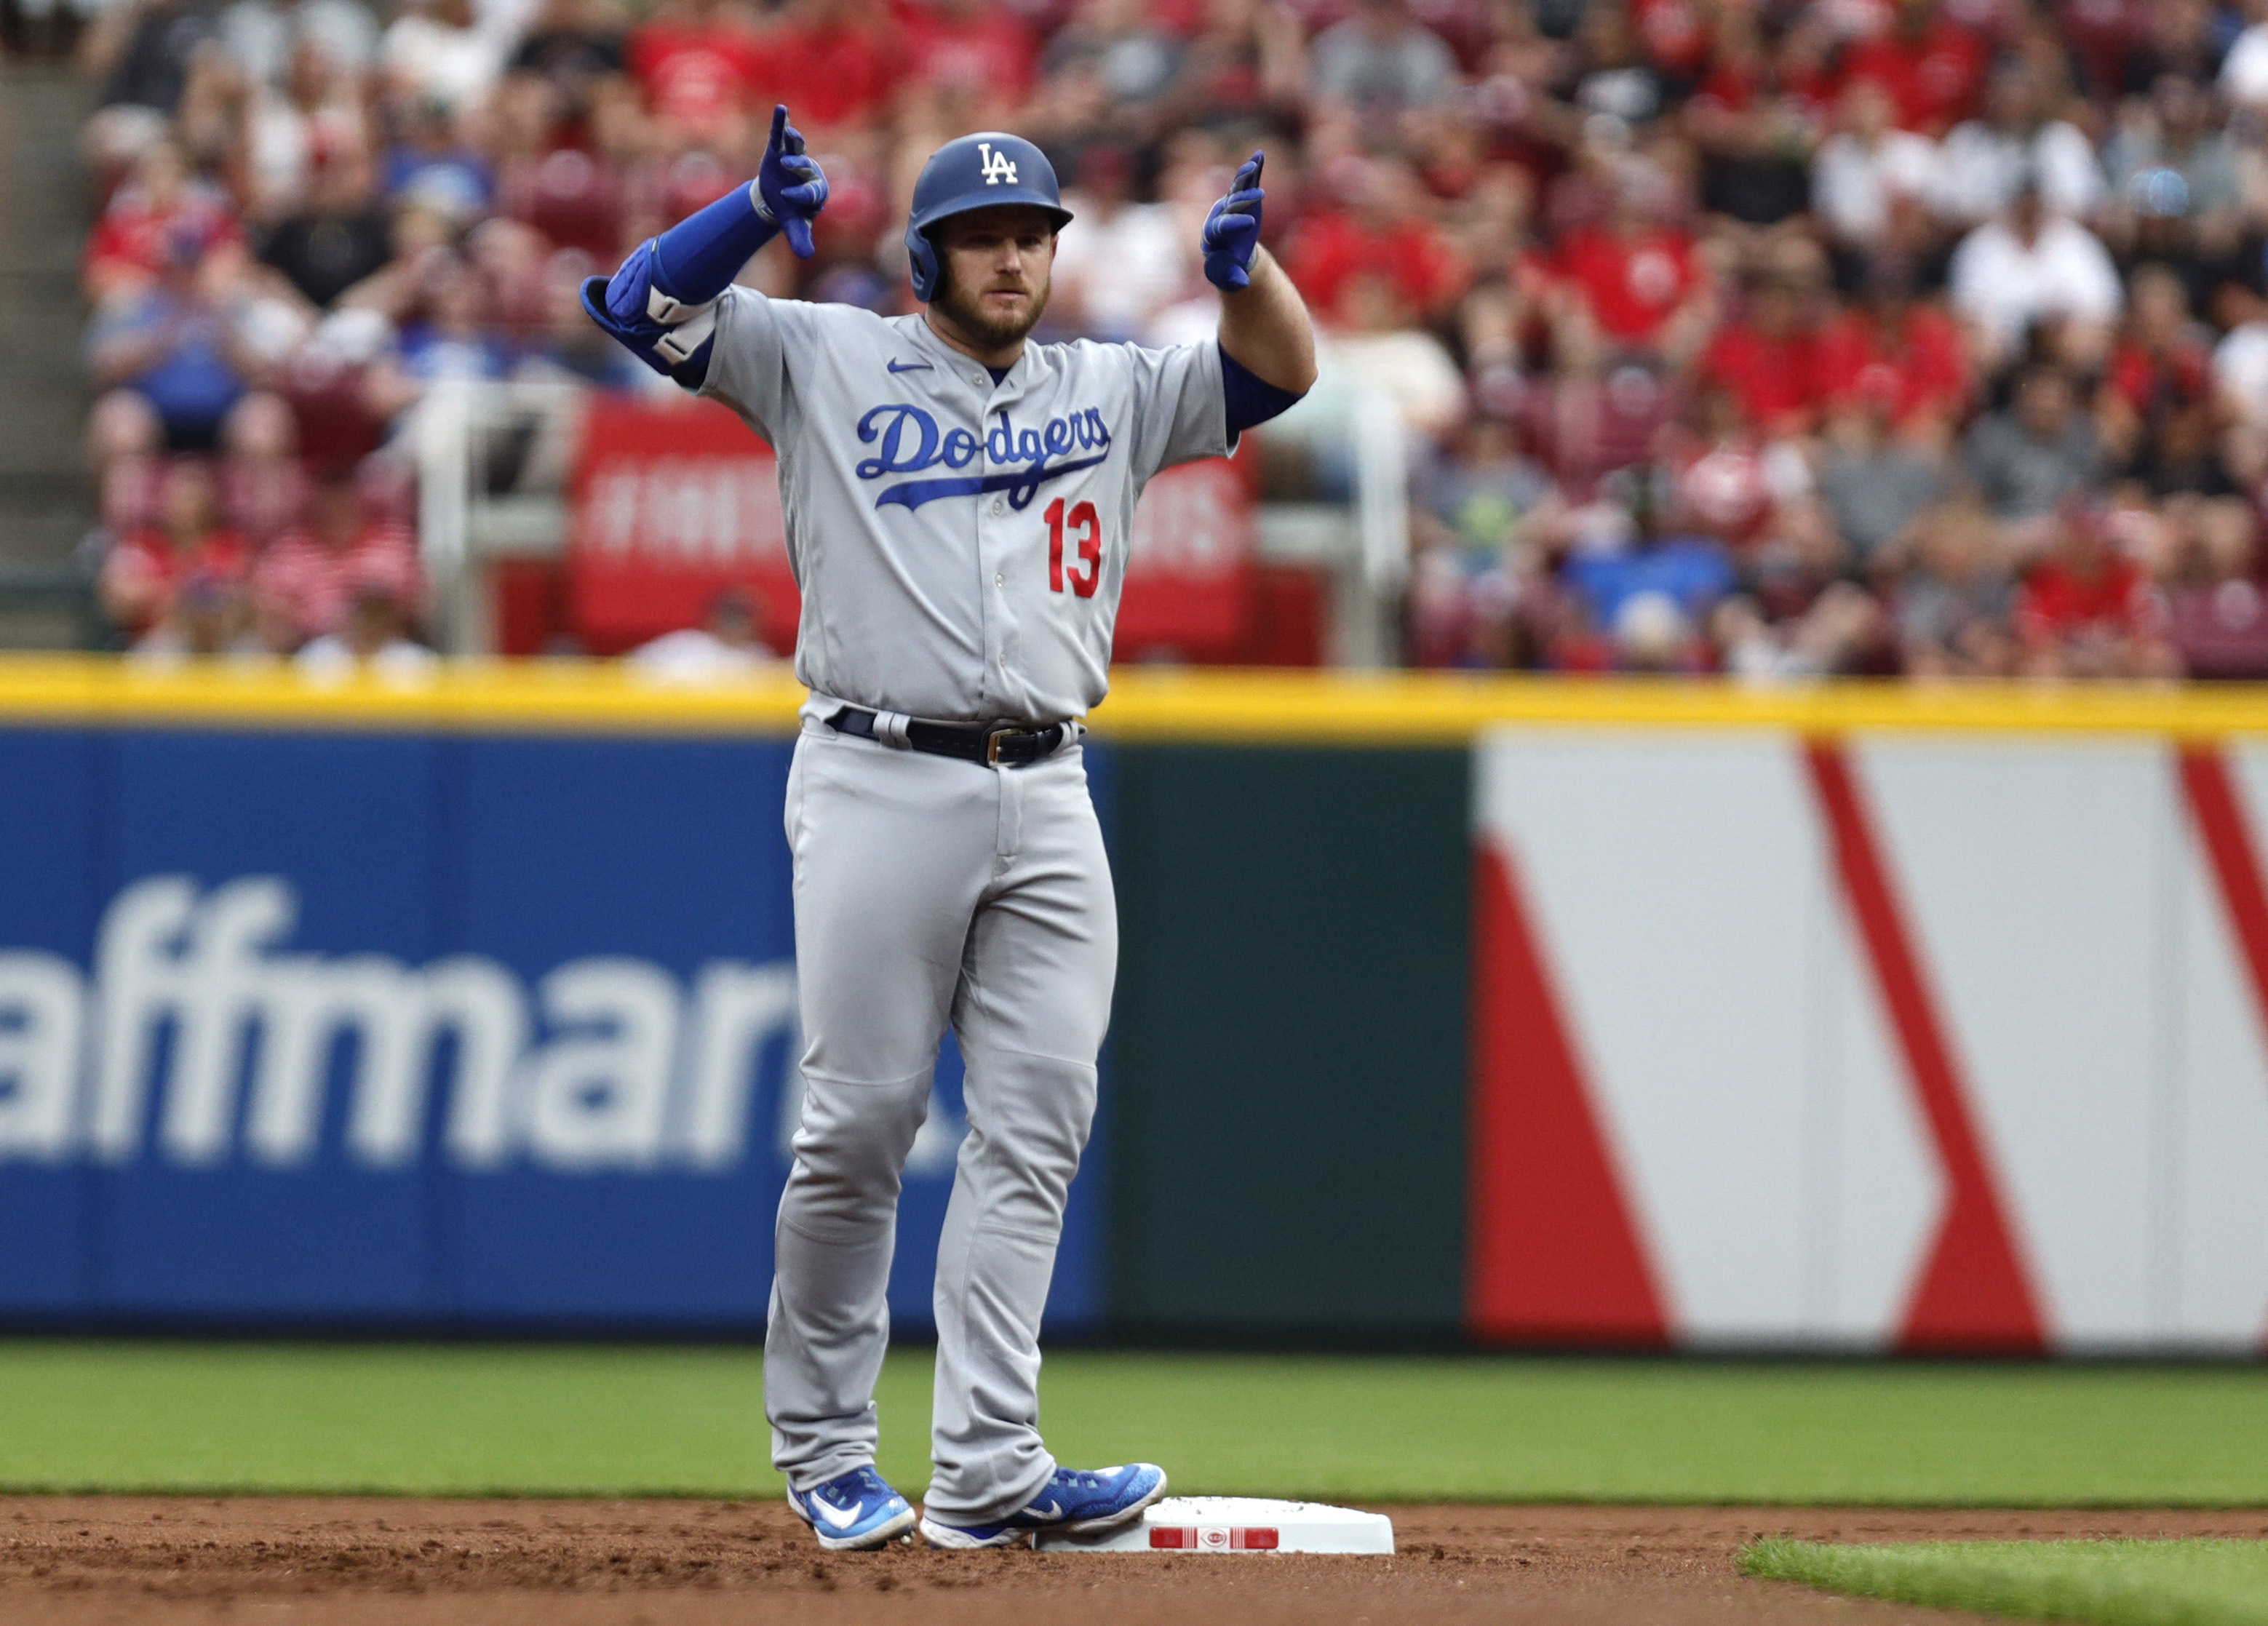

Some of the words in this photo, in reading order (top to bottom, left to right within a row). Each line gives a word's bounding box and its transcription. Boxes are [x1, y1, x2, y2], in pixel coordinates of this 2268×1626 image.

[978, 143, 1018, 185] LA
[856, 404, 1110, 512] Dodgers
[1043, 497, 1101, 598] 13
